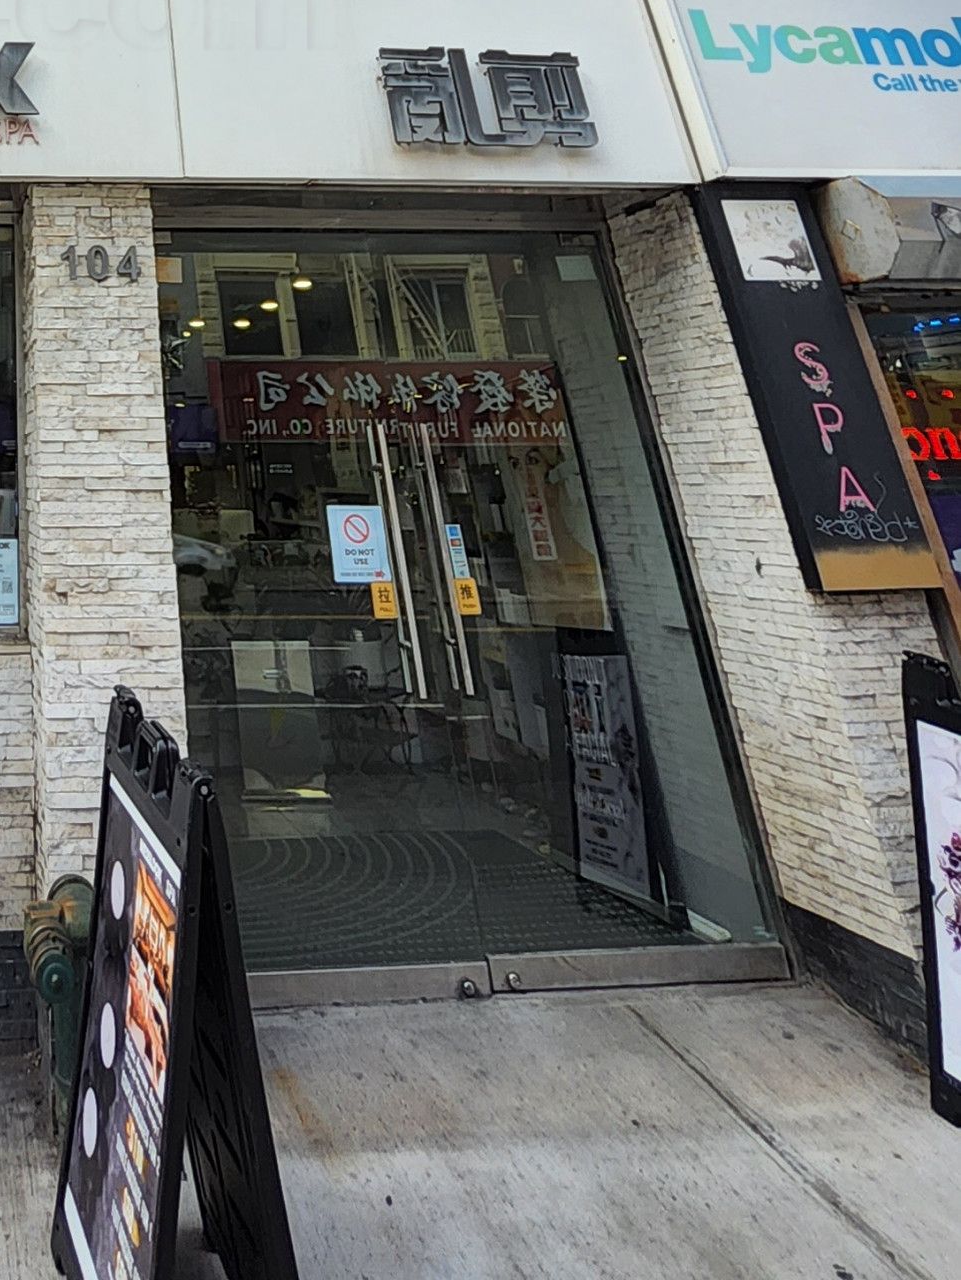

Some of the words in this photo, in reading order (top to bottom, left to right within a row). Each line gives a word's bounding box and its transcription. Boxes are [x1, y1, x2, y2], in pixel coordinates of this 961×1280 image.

[873, 73, 917, 92] Call
[918, 74, 958, 92] the
[61, 245, 141, 282] 104
[794, 341, 876, 513] SPA
[345, 548, 358, 556] DO
[358, 548, 375, 556] NOT
[354, 558, 369, 566] USE
